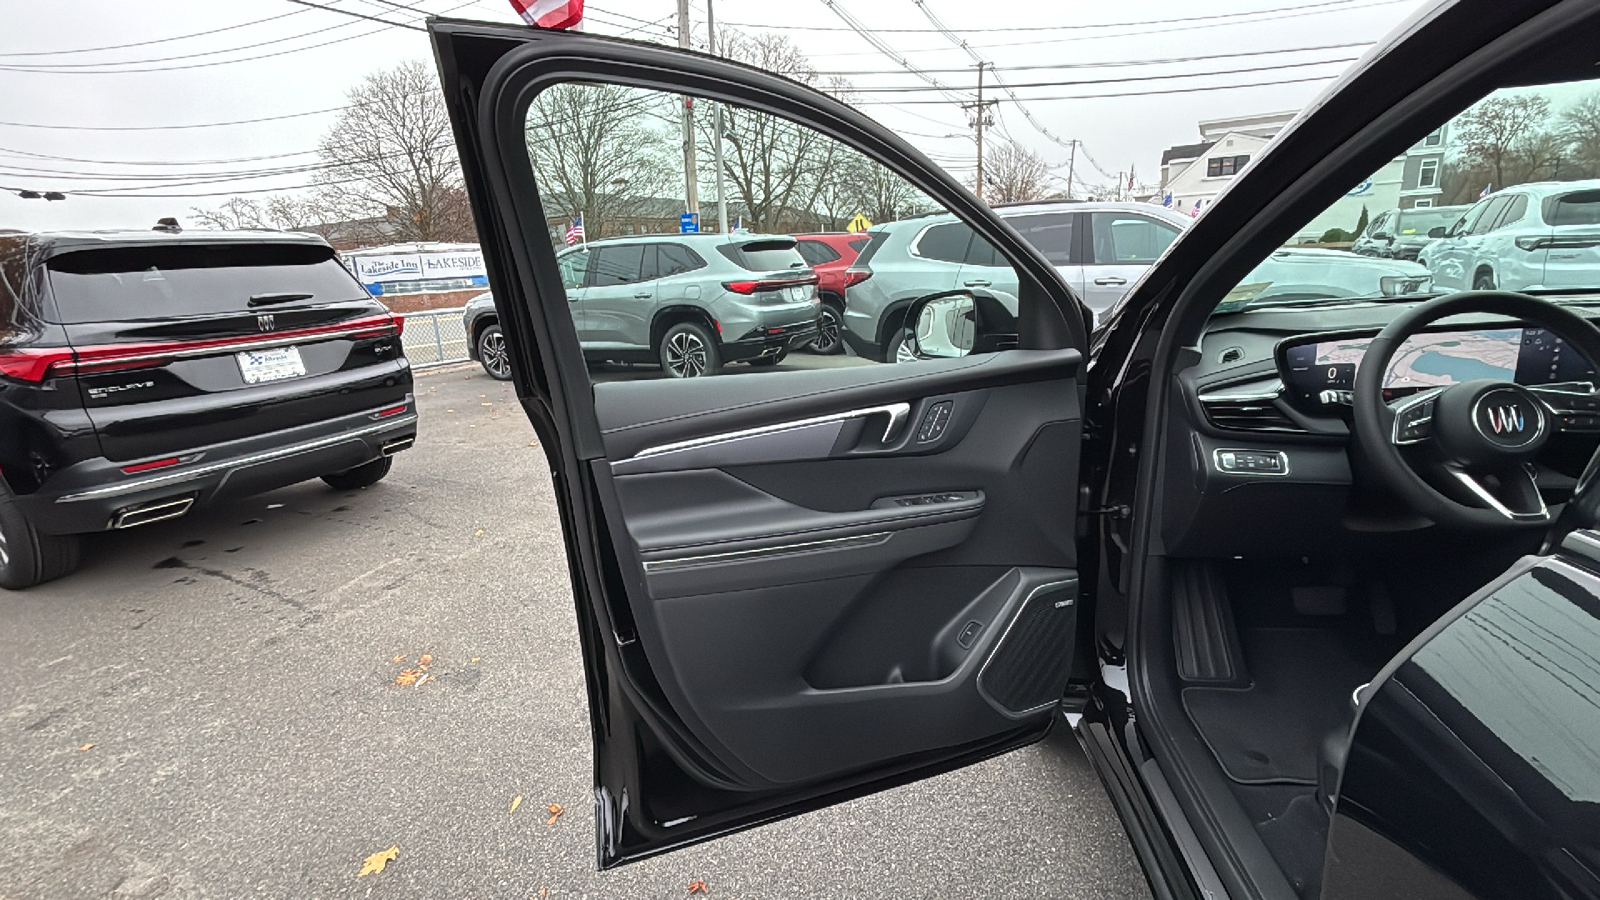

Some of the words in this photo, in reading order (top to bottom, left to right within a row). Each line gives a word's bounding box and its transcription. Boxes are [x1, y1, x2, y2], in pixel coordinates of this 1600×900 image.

[361, 260, 399, 274] Lakeside
[401, 259, 418, 269] Inn
[427, 256, 482, 269] LAKESIDE
